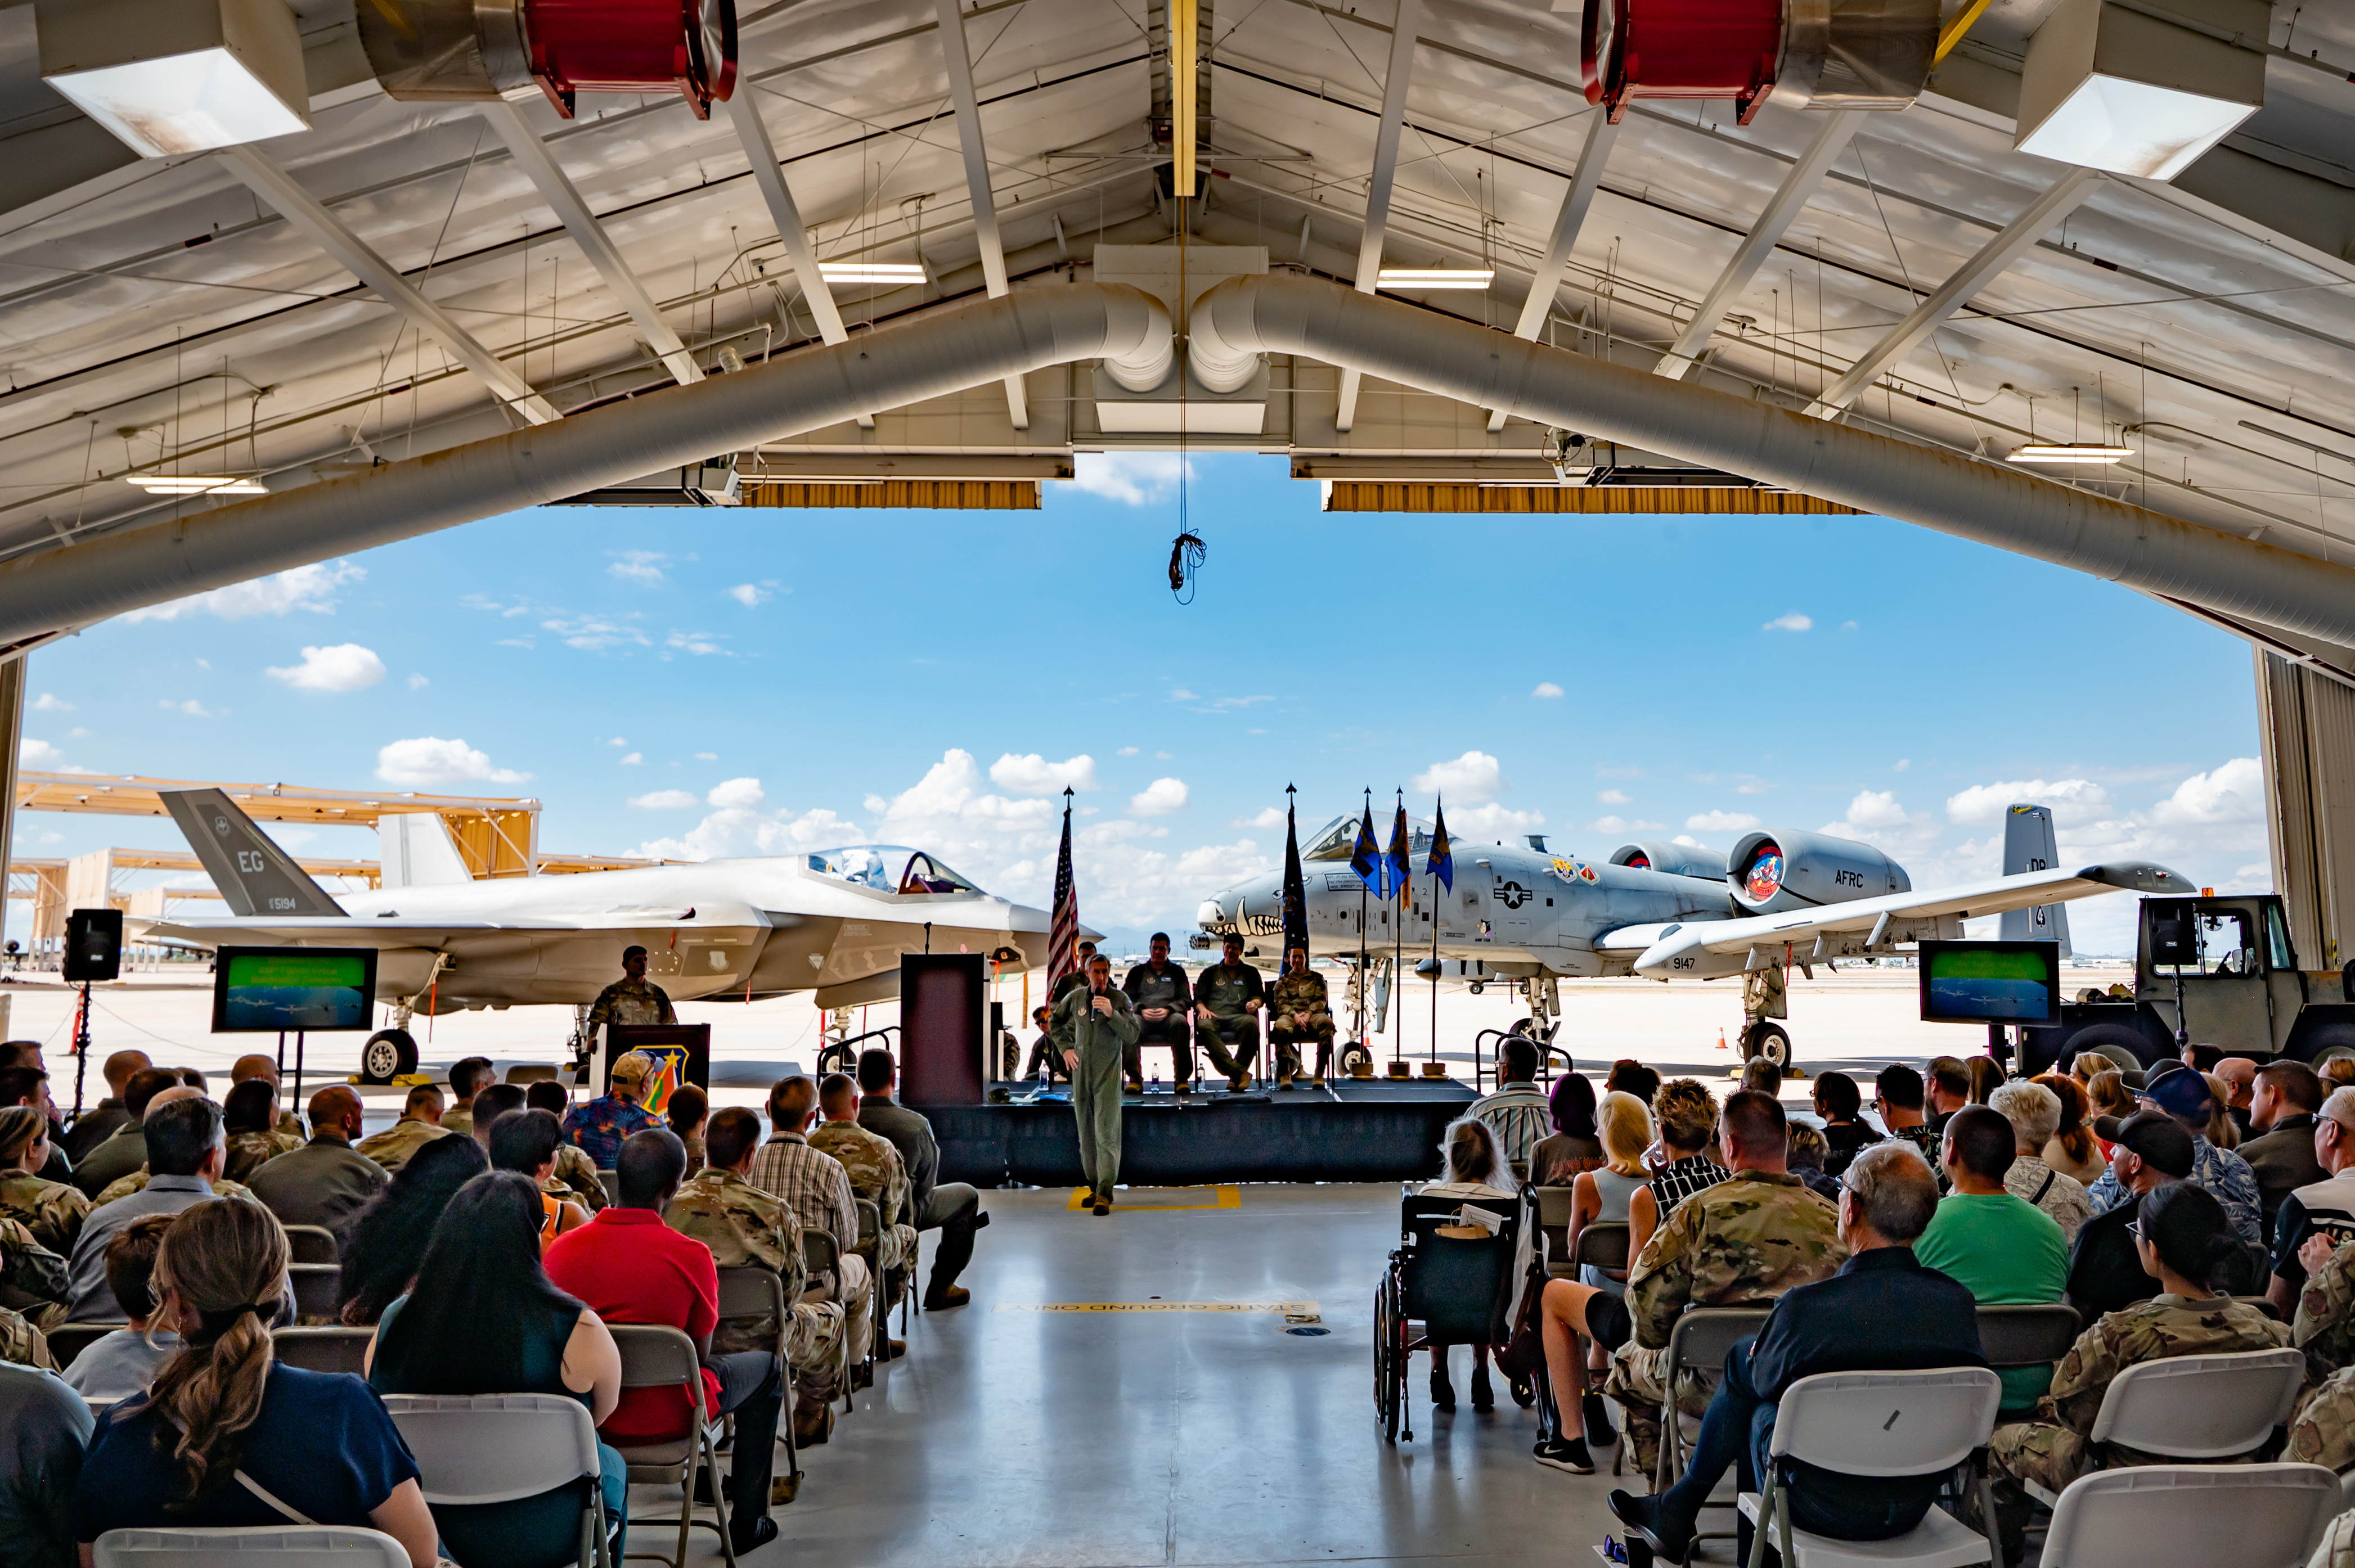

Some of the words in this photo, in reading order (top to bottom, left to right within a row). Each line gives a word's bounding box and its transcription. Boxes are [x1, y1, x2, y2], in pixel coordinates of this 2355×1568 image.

[237, 851, 264, 872] EG
[1835, 869, 1863, 888] AFRC
[275, 898, 296, 909] 5194
[2038, 908, 2043, 923] 4
[1674, 958, 1695, 969] 9147
